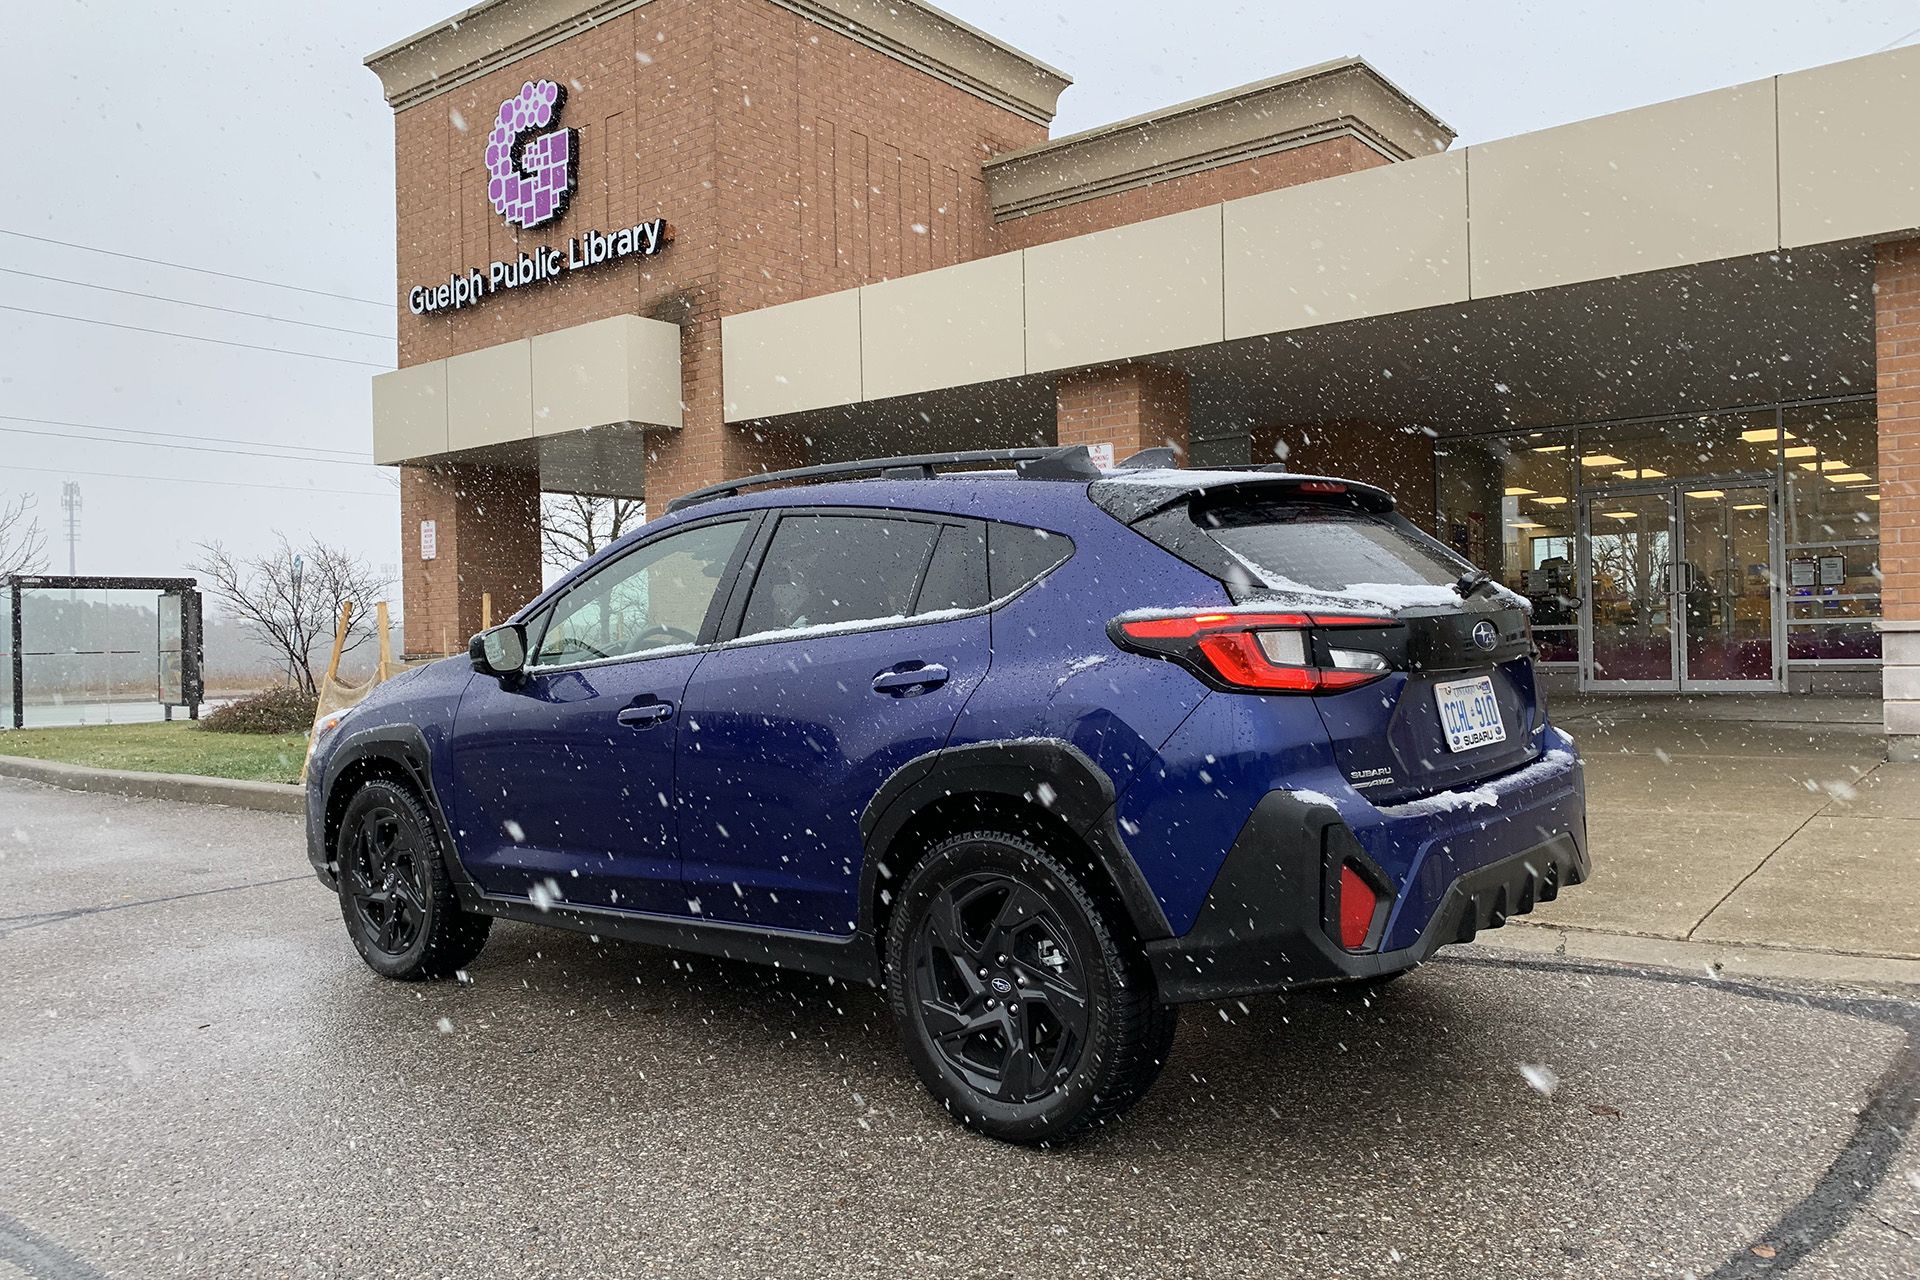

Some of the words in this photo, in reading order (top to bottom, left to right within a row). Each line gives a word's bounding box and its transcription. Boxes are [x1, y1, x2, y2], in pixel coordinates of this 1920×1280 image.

[409, 267, 484, 315] Guelph
[490, 246, 561, 292] Public
[568, 219, 661, 270] Library
[1444, 699, 1474, 734] CCHL
[1474, 695, 1498, 728] 910
[1463, 730, 1494, 746] SUBARU
[1350, 766, 1392, 779] SUBARU
[1368, 777, 1395, 787] AWD
[891, 903, 911, 1017] BRIDGESTON
